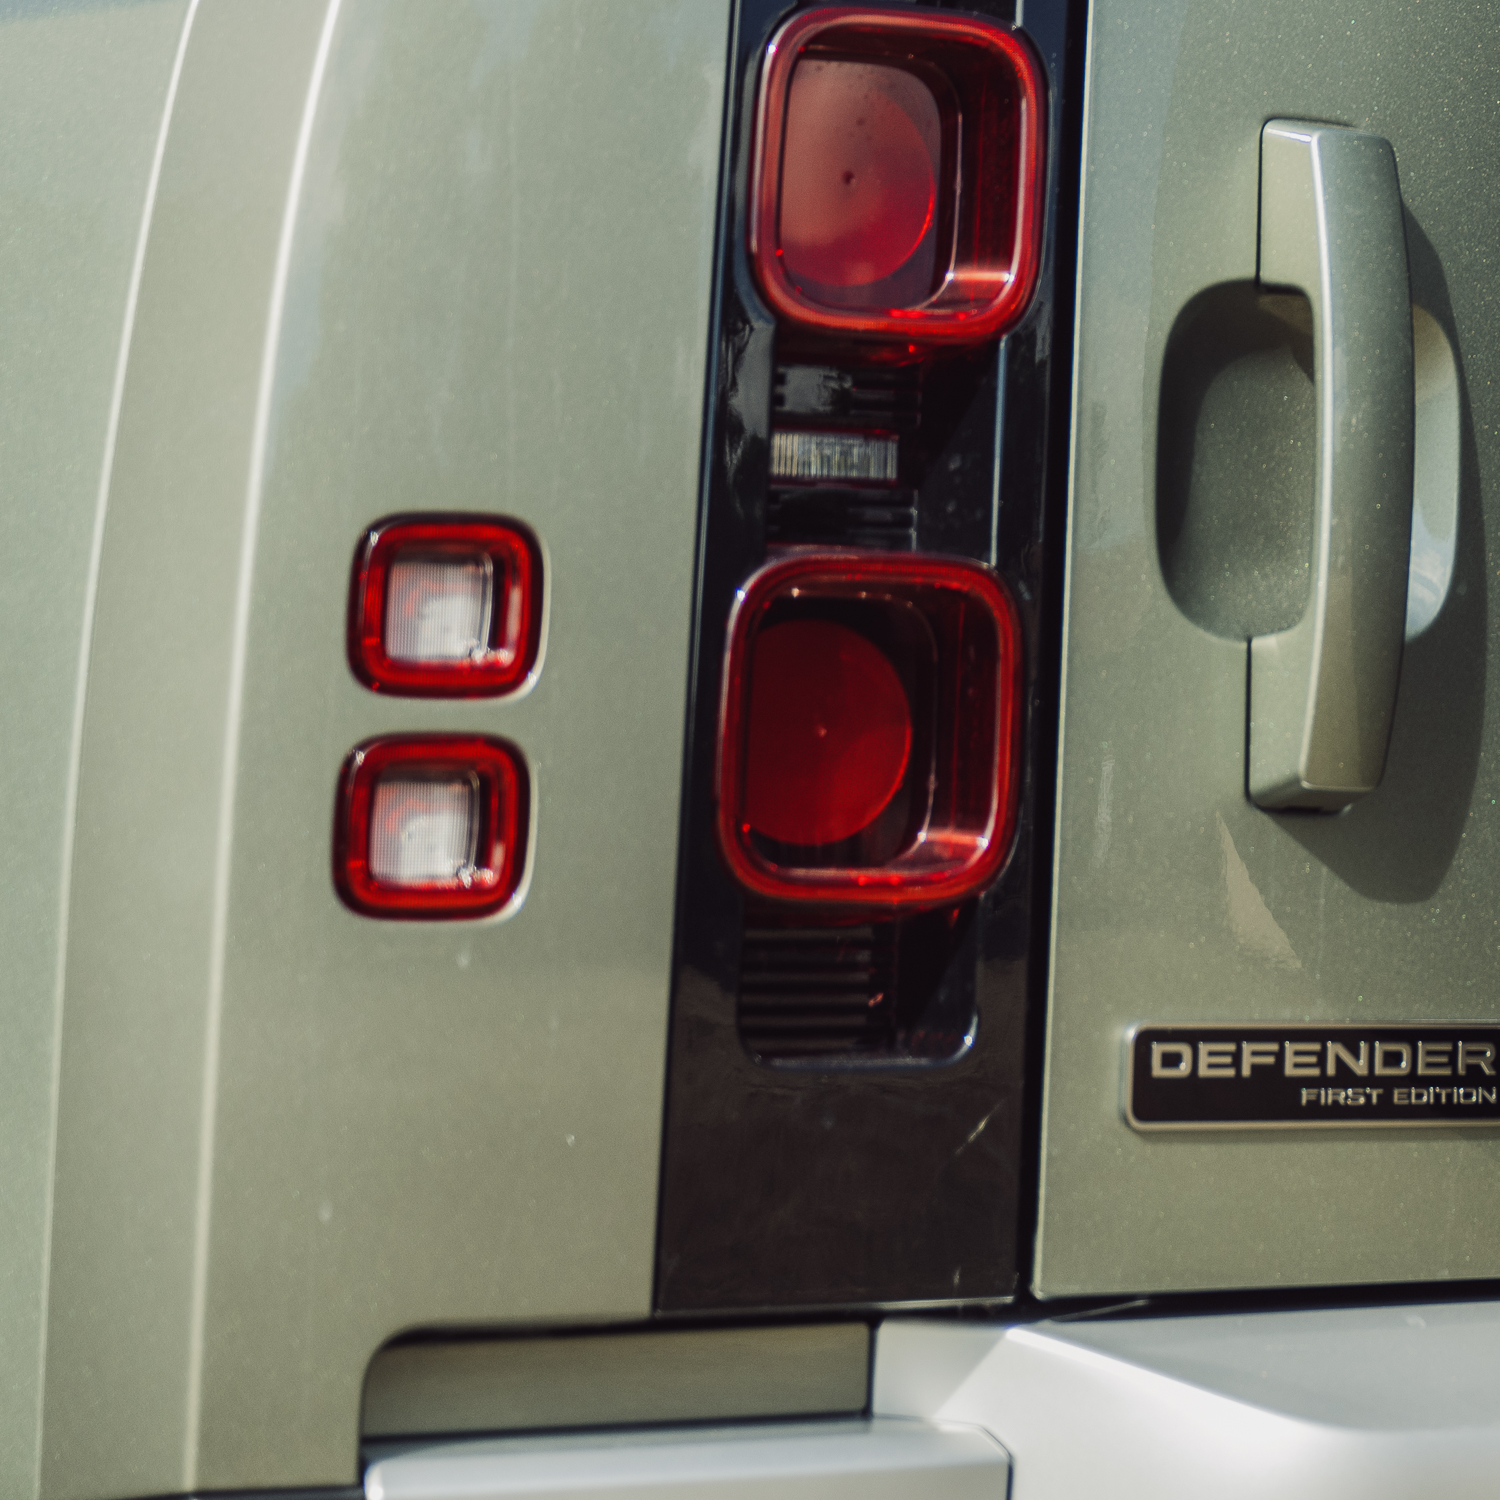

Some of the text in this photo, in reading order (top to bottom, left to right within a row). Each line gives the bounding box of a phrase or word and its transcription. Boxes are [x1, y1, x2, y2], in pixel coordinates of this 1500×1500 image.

[1151, 1041, 1497, 1078] DEFENDER
[1301, 1086, 1497, 1106] FIRST EDITION
